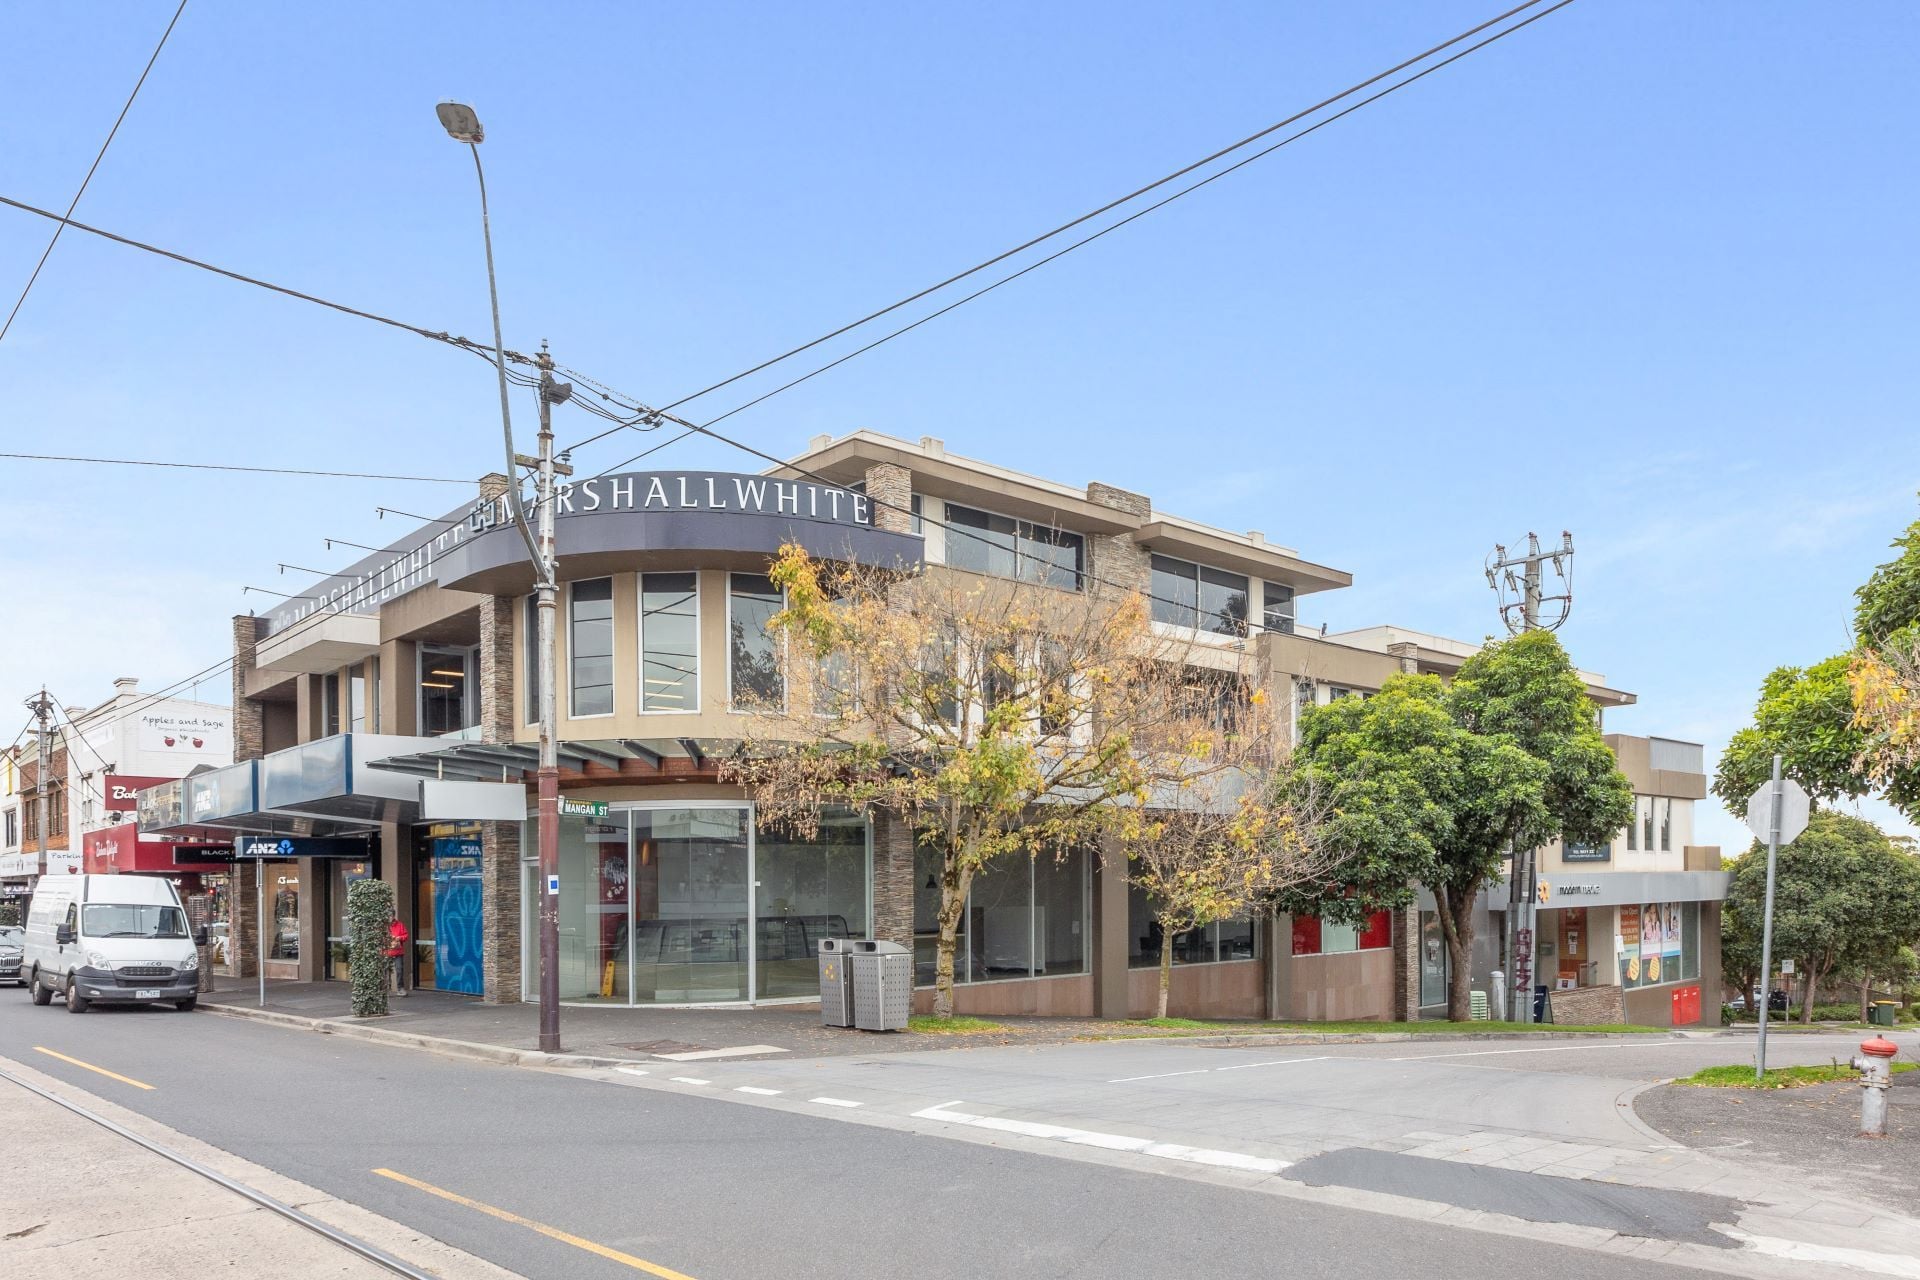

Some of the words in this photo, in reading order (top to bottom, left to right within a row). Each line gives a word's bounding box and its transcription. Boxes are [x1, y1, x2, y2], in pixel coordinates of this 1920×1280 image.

[142, 715, 174, 727] Apples
[565, 803, 595, 815] MANGAN
[598, 806, 608, 816] ST
[246, 843, 278, 854] ANZ
